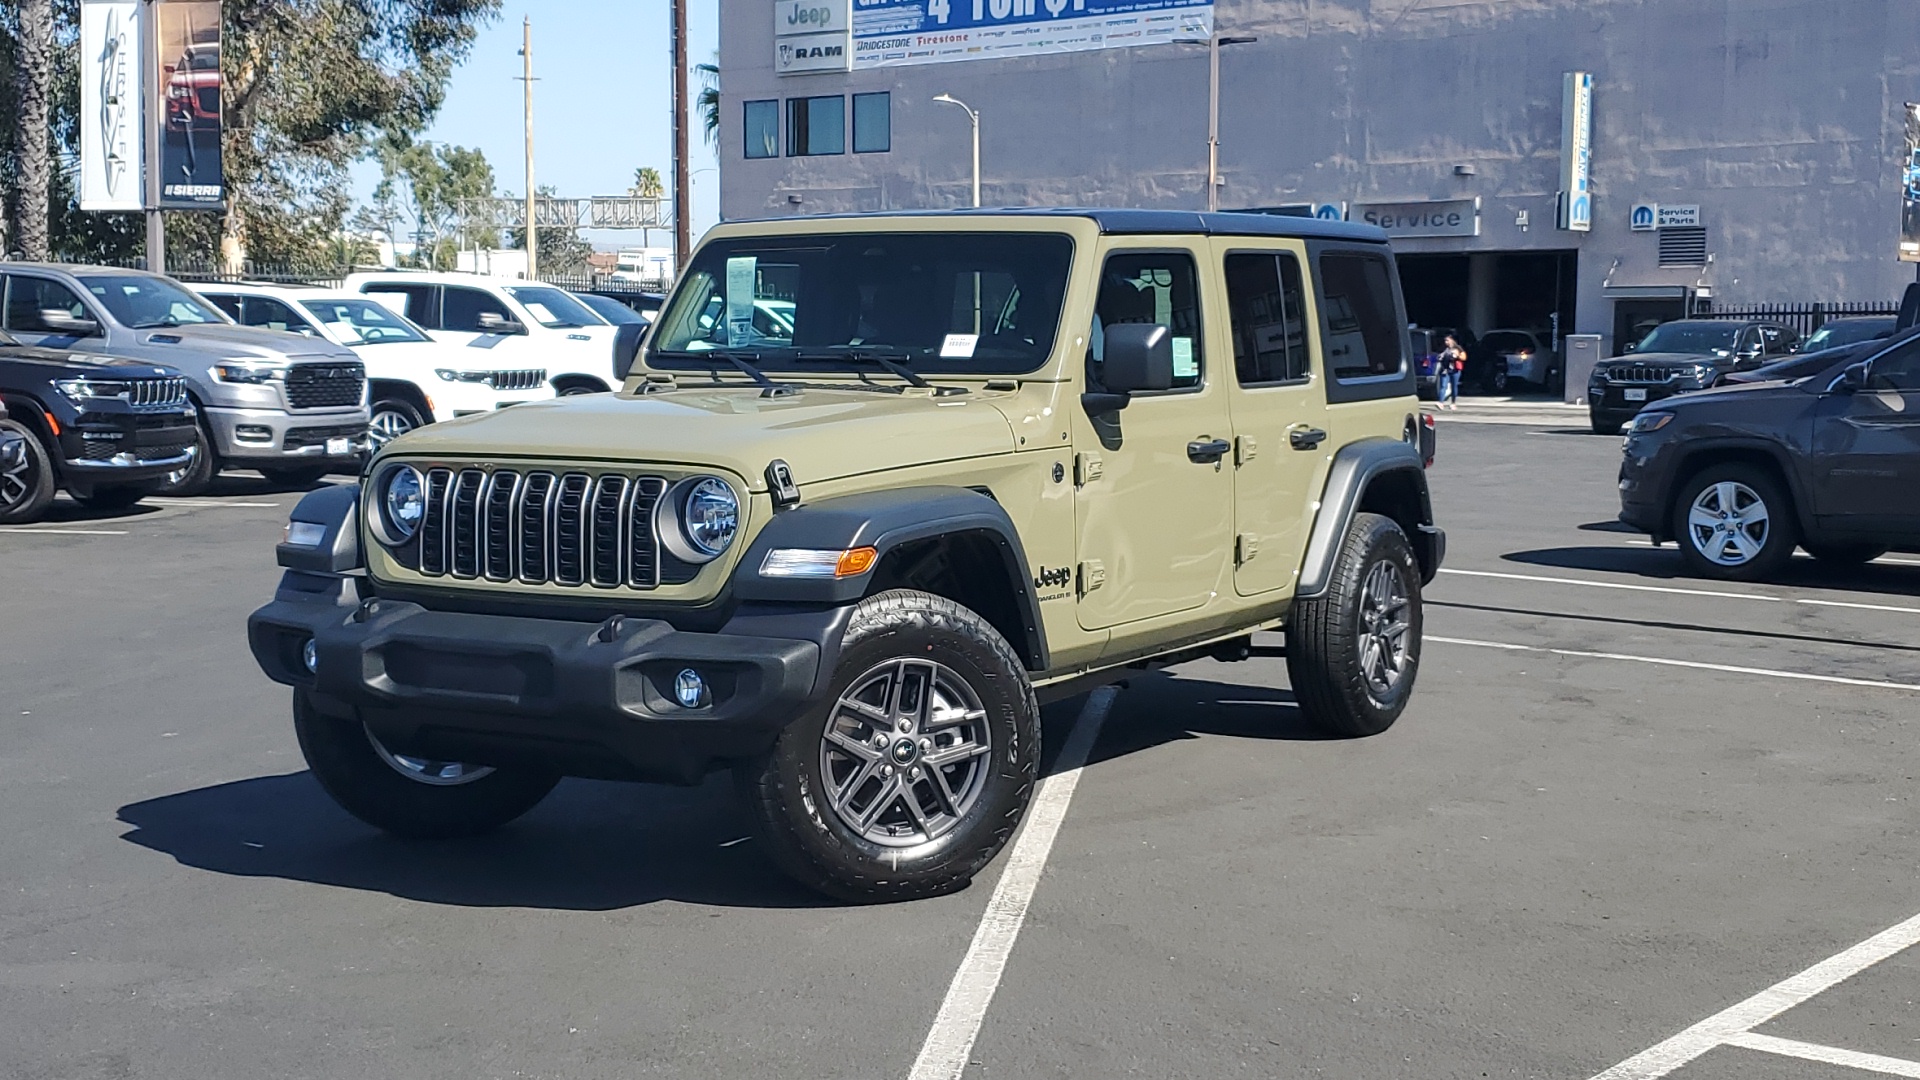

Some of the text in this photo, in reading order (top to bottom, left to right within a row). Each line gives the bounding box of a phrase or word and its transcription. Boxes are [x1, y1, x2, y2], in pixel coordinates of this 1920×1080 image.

[788, 3, 831, 28] Jeep
[856, 37, 911, 51] BRIDGESTONE
[916, 34, 969, 47] Firestone
[795, 45, 843, 59] RAM
[118, 32, 126, 173] CHRYSLER
[173, 184, 221, 196] SIERRA
[1363, 211, 1461, 229] Service
[1658, 208, 1695, 216] Service
[1669, 217, 1695, 225] Parts
[1034, 565, 1071, 588] Jeep
